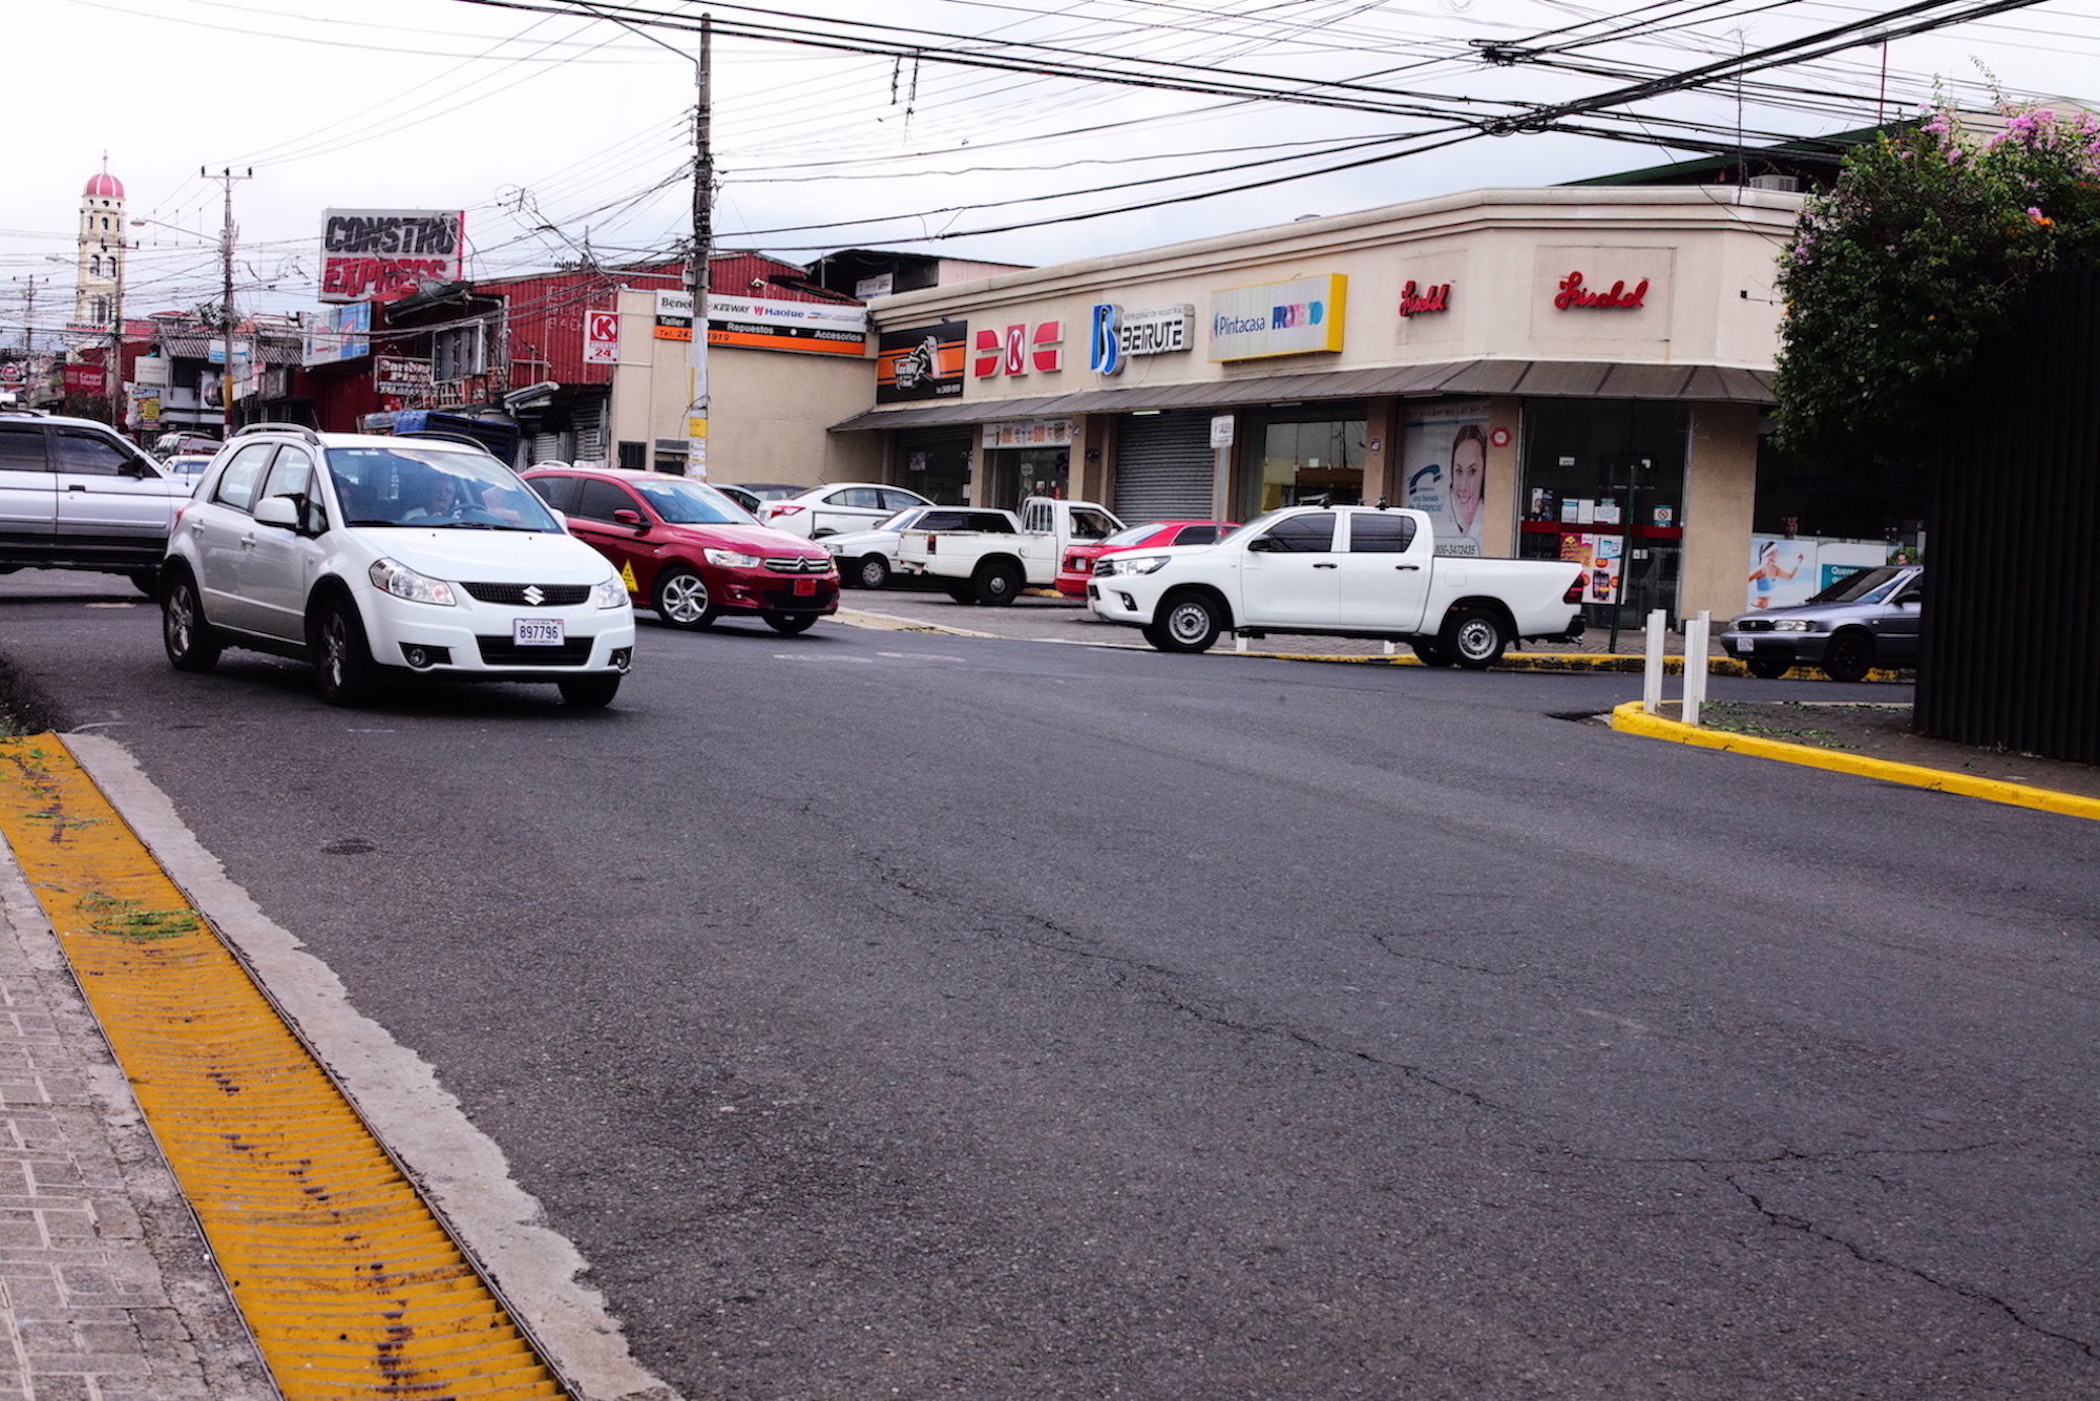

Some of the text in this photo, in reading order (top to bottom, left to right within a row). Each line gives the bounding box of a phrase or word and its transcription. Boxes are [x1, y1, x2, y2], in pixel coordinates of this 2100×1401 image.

[325, 216, 459, 253] CONSTRU
[323, 257, 446, 296] EXPRESS
[714, 303, 751, 313] KEEWAY
[765, 308, 805, 318] Haojue
[660, 317, 862, 342] Taller Repuestos Accesorios
[1122, 320, 1182, 352] BEIRUTE
[1220, 315, 1265, 335] Pintacasa
[595, 349, 611, 357] 24
[520, 625, 558, 639] 897796
